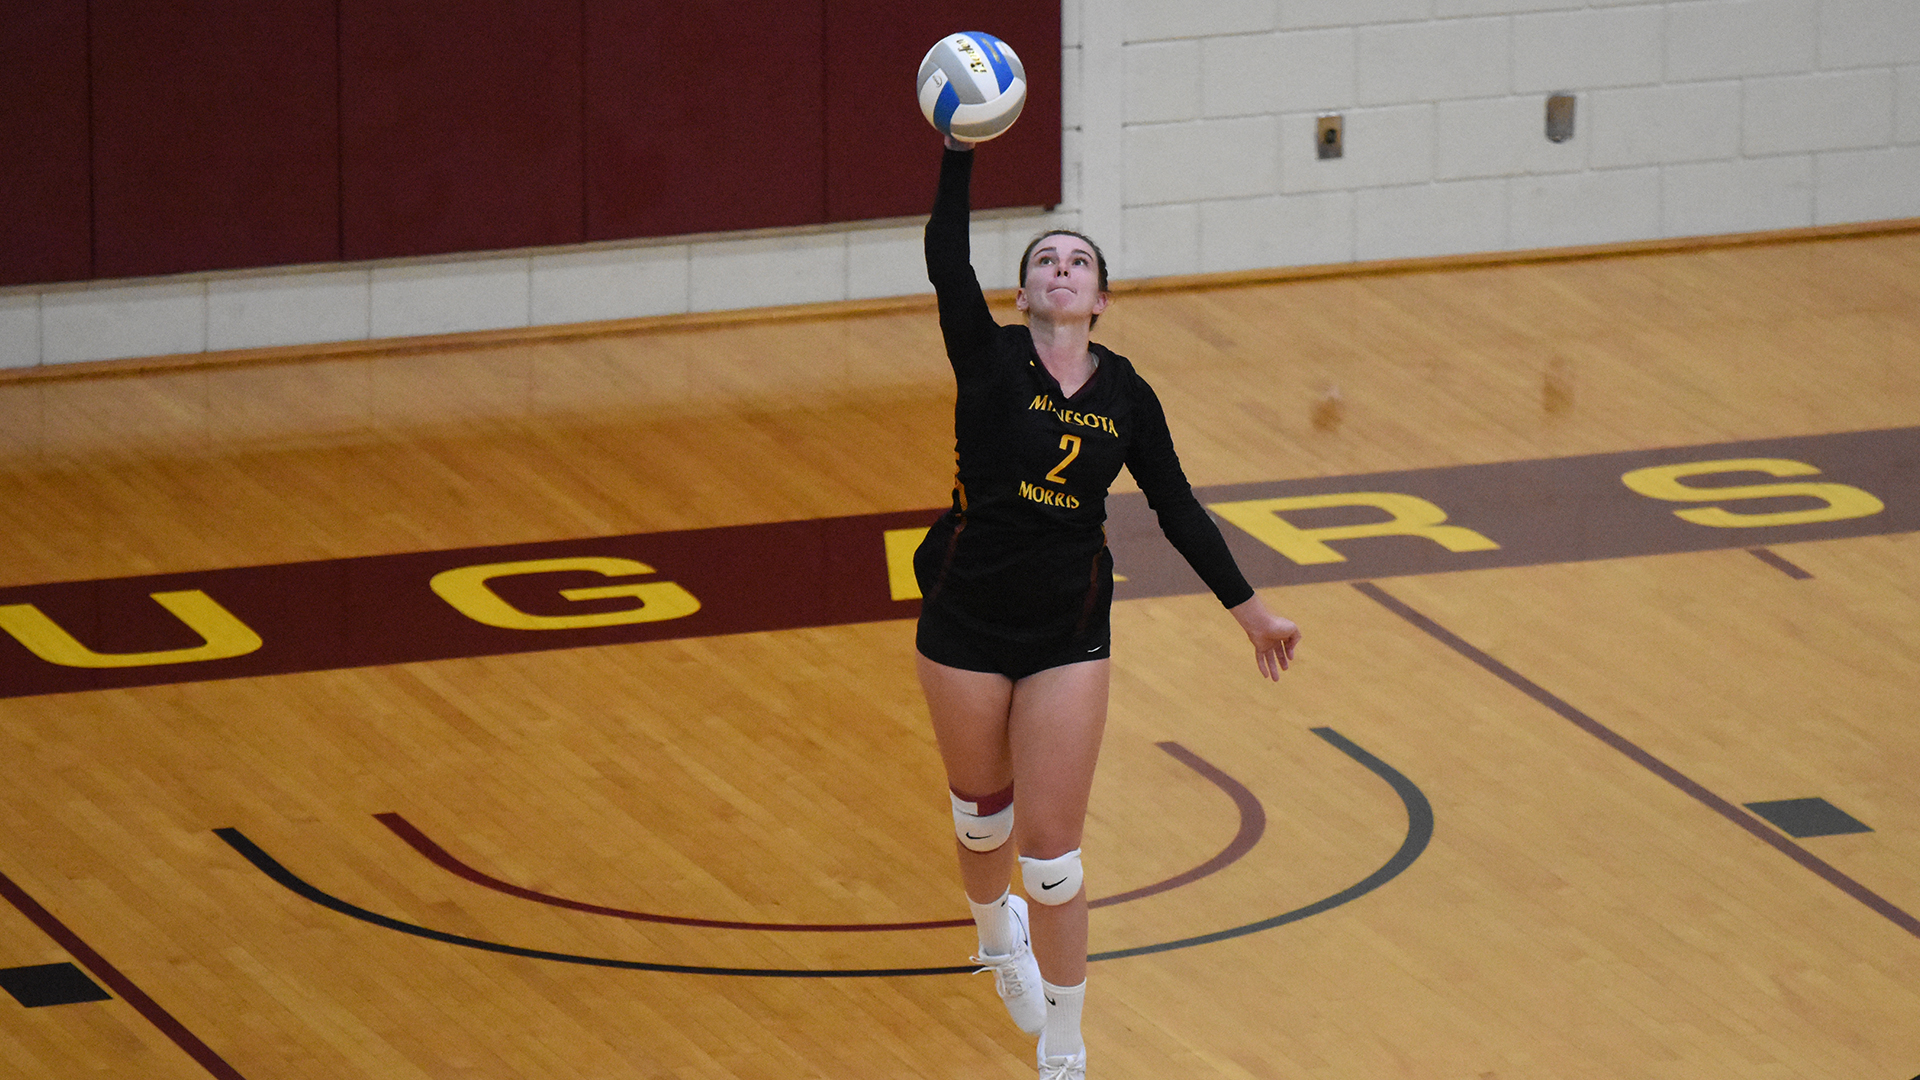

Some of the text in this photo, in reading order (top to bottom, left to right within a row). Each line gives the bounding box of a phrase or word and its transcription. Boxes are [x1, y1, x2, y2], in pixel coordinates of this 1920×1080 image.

[1028, 395, 1118, 437] MINESOTA
[1045, 434, 1081, 484] 2
[1018, 480, 1080, 509] MORRIS
[0, 458, 1884, 668] UGRS
